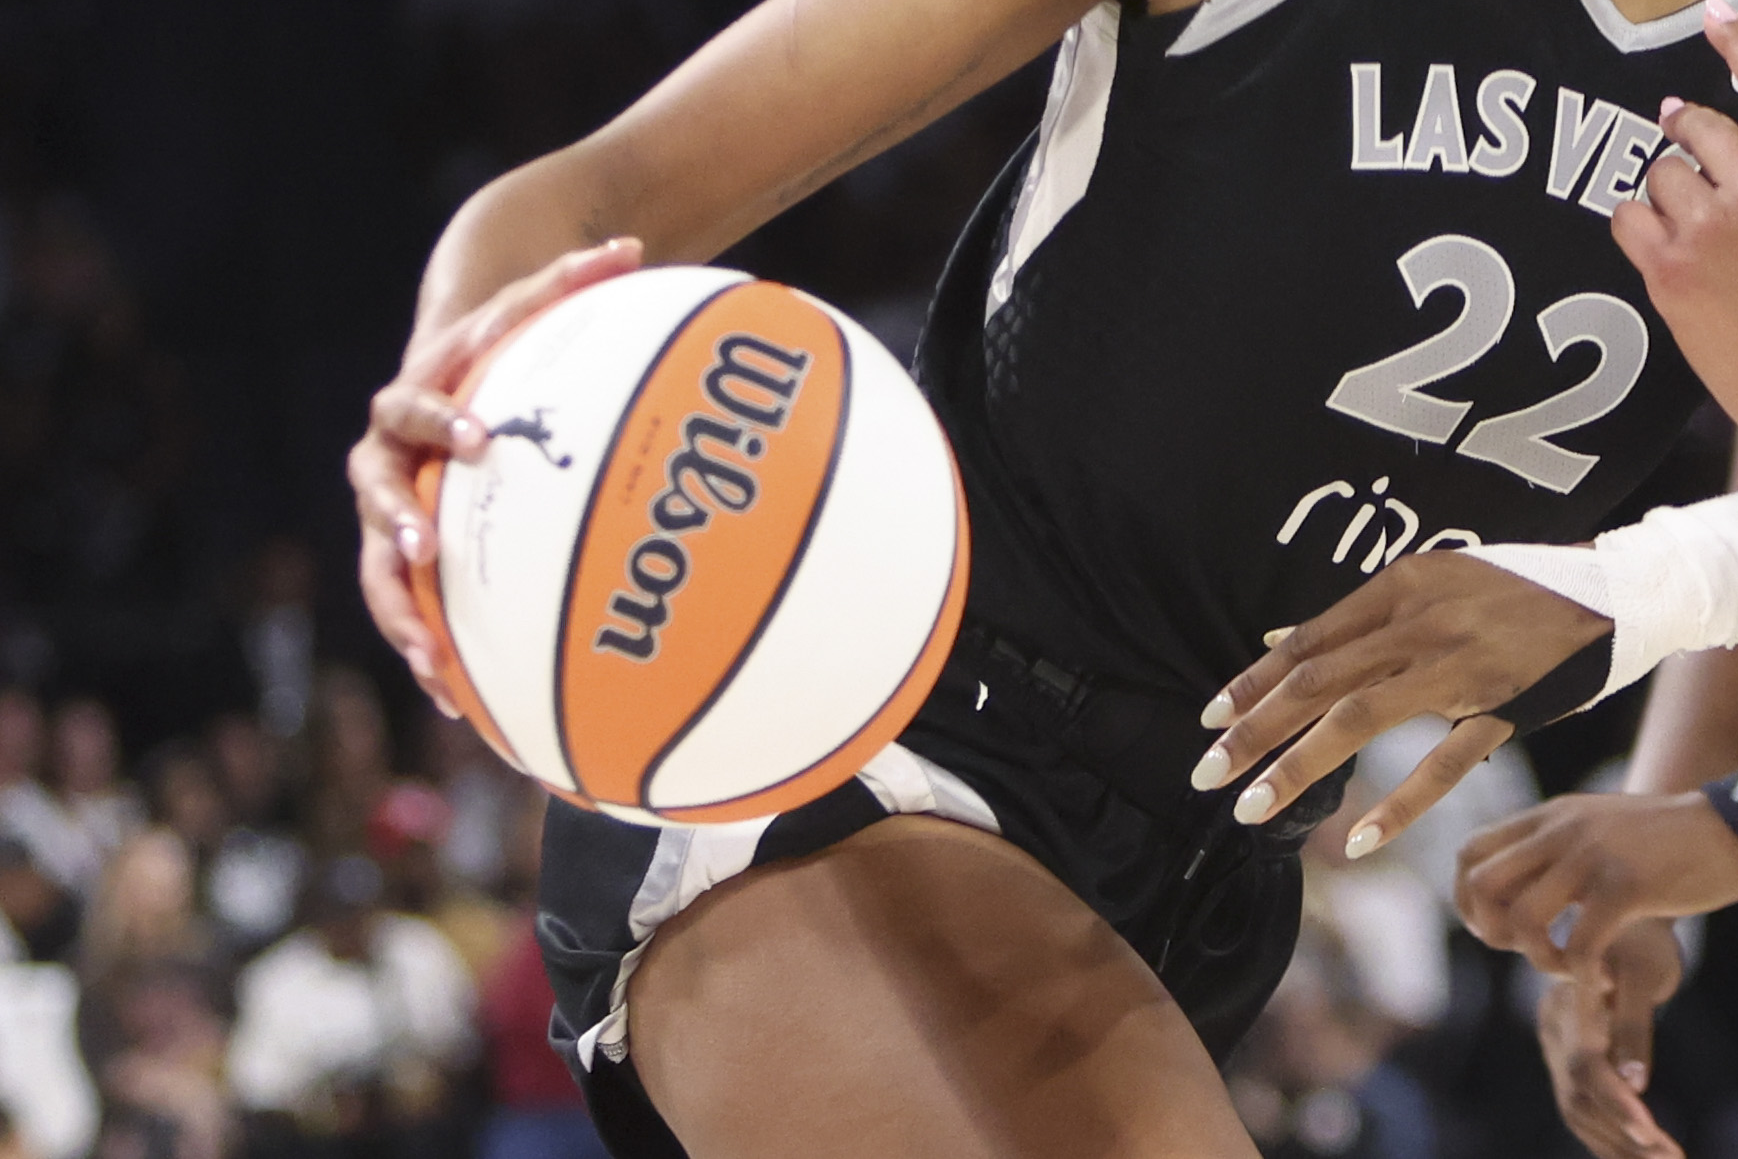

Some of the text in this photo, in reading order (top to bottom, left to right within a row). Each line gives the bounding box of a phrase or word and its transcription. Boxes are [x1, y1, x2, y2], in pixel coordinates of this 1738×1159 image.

[1350, 62, 1536, 176] LAS
[1326, 233, 1649, 495] 22
[591, 331, 814, 664] Wilson
